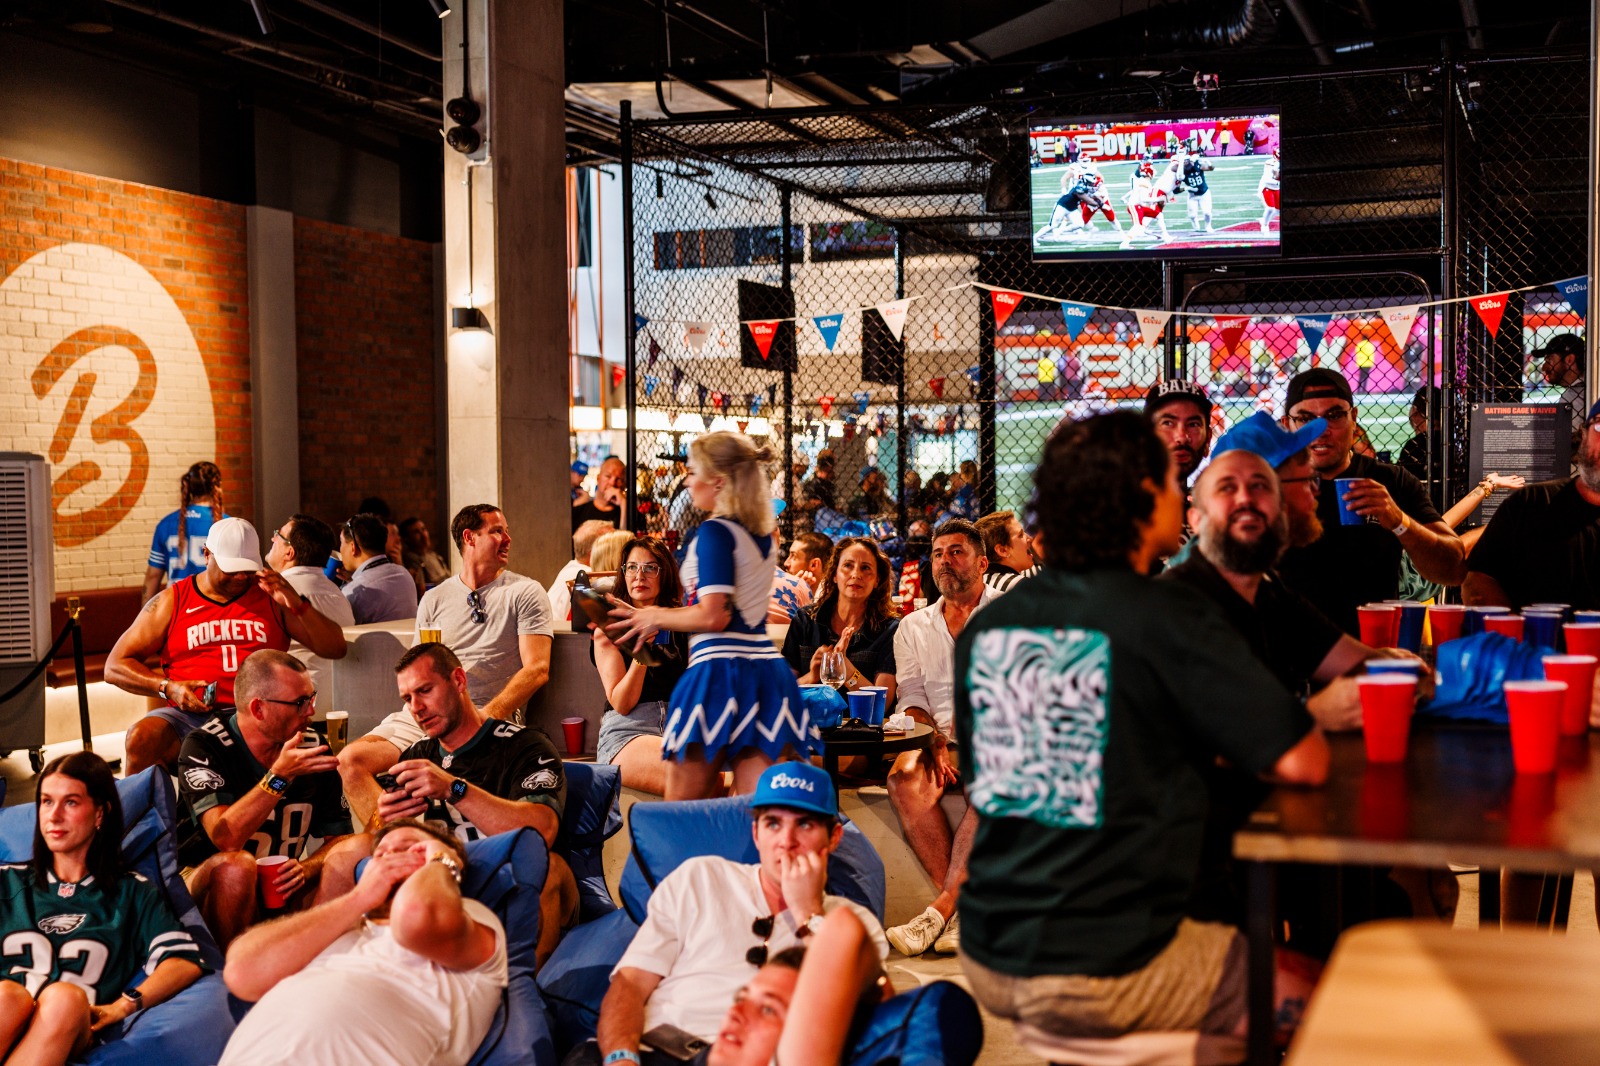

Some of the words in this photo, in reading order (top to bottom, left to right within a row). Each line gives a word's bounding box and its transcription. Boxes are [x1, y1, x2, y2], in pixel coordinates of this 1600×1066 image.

[1479, 300, 1501, 310] Coors
[1485, 407, 1511, 415] BATTING
[1512, 407, 1529, 415] CAGE
[1530, 407, 1557, 415] WAIVER
[30, 325, 158, 548] B
[187, 619, 268, 650] ROCKETS
[221, 644, 238, 672] 0
[770, 772, 814, 792] Coors
